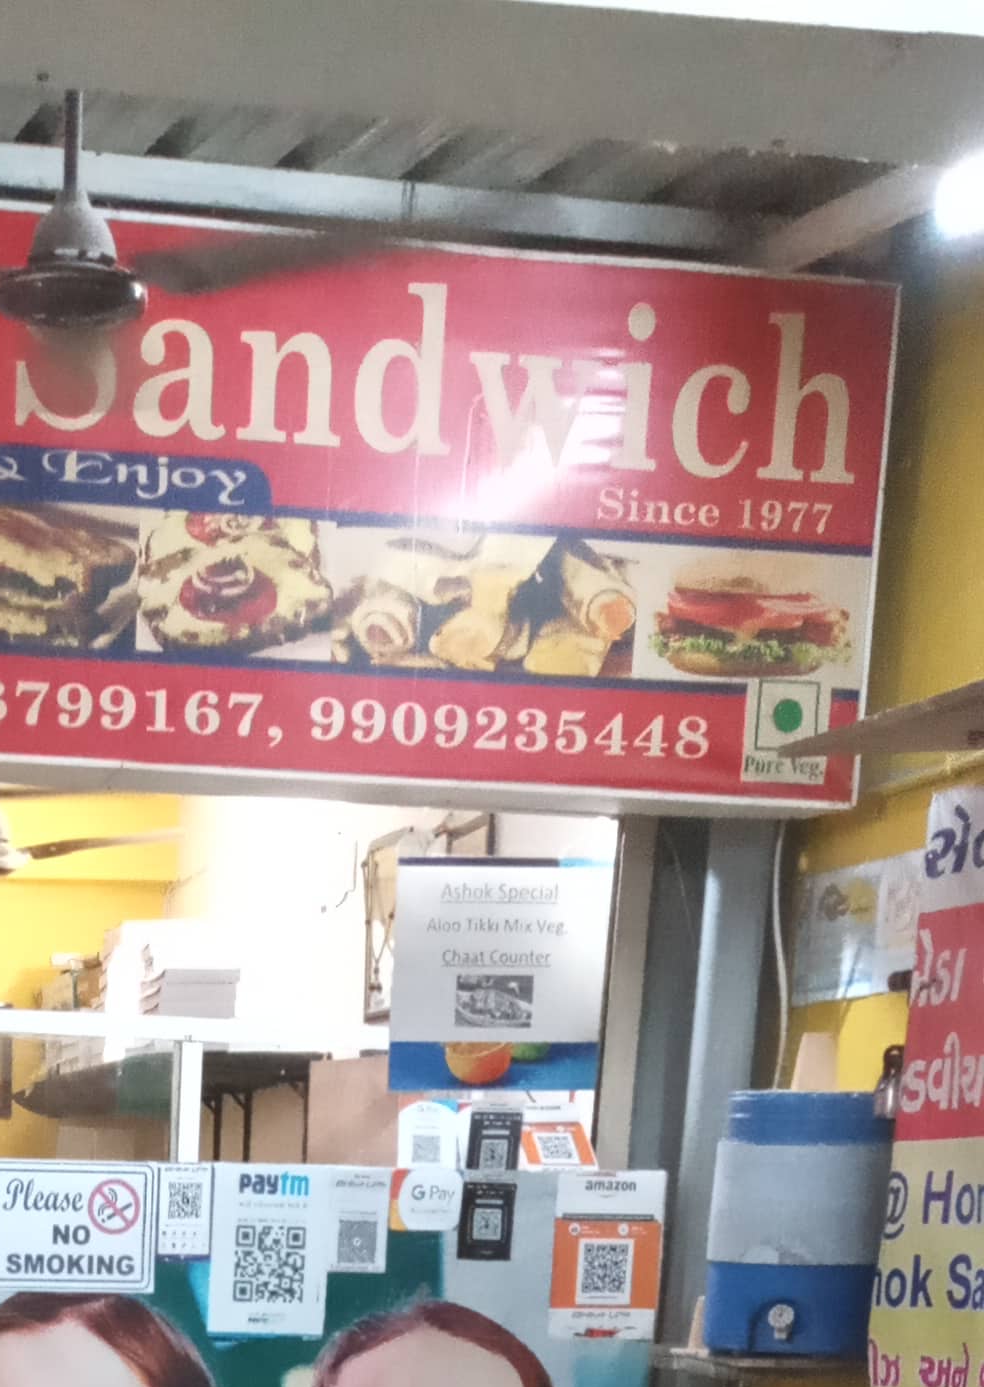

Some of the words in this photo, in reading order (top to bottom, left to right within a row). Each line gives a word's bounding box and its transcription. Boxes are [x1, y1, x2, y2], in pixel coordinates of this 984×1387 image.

[15, 281, 855, 485] Sandwich
[42, 449, 247, 505] Enjoy
[596, 486, 720, 527] Since
[739, 498, 834, 535] 1977
[309, 695, 710, 759] 9909235448
[440, 882, 493, 900] Ashok
[498, 882, 560, 904] Special
[426, 917, 462, 934] Aloo
[466, 917, 500, 934] Tikki
[504, 918, 532, 934] Mix
[536, 918, 569, 936] Veg.
[441, 949, 485, 966] Chaat
[489, 949, 552, 966] Counter
[2, 1177, 84, 1213] Please
[428, 1184, 456, 1206] Pay
[584, 1179, 637, 1192] amazon
[922, 1169, 984, 1226] Ho
[52, 1224, 91, 1245] NO
[5, 1253, 136, 1276] SMOKING
